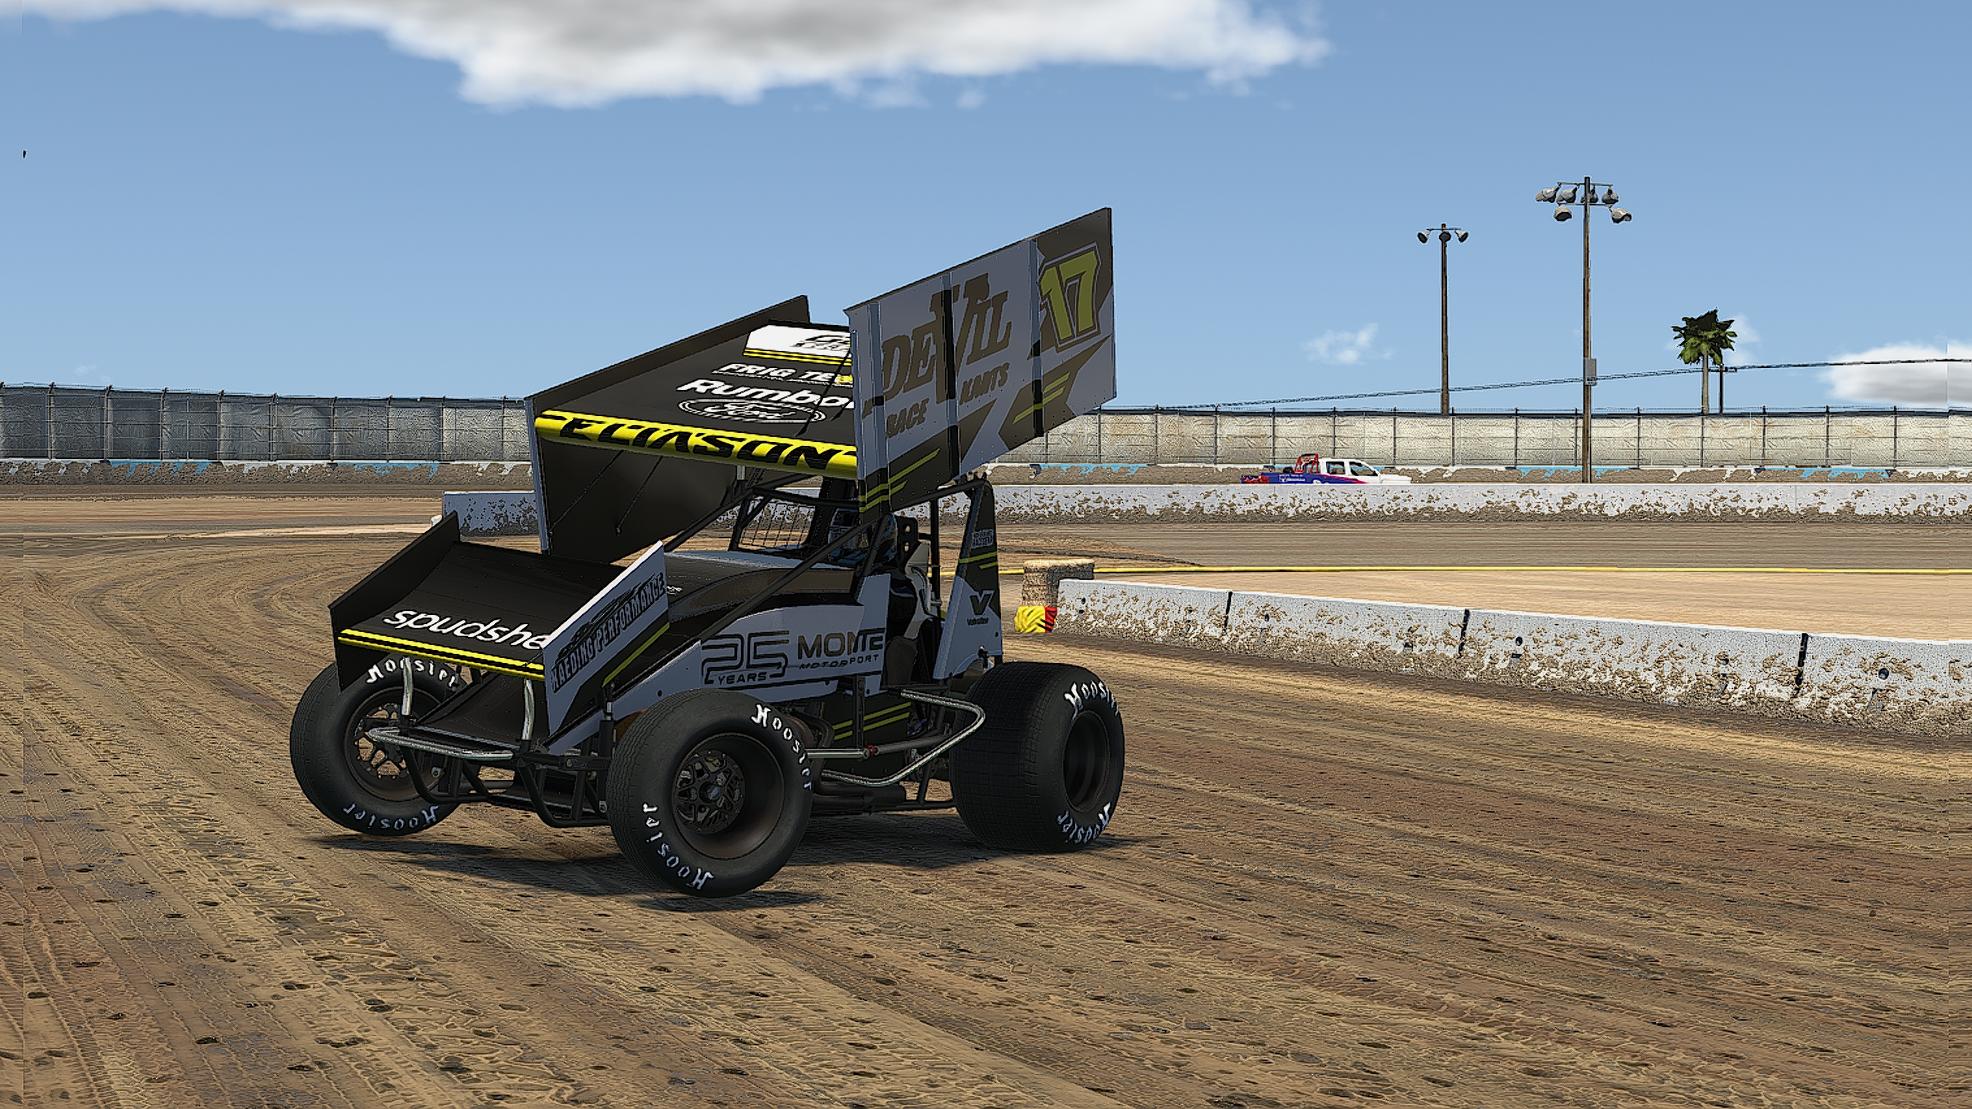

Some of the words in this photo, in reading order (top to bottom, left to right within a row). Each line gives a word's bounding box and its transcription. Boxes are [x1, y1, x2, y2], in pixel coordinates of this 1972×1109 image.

[1040, 248, 1099, 346] 17
[883, 273, 1011, 403] DEVIL
[719, 363, 797, 378] FRIG
[676, 379, 854, 409] Rumbo
[887, 398, 929, 438] RACE
[559, 418, 840, 470] ELIASON
[551, 636, 597, 693] KAEDING
[594, 572, 666, 652] PERFORMANCE
[717, 671, 768, 686] YEARS
[343, 803, 439, 831] Hoosier
[642, 802, 715, 891] Hoosier
